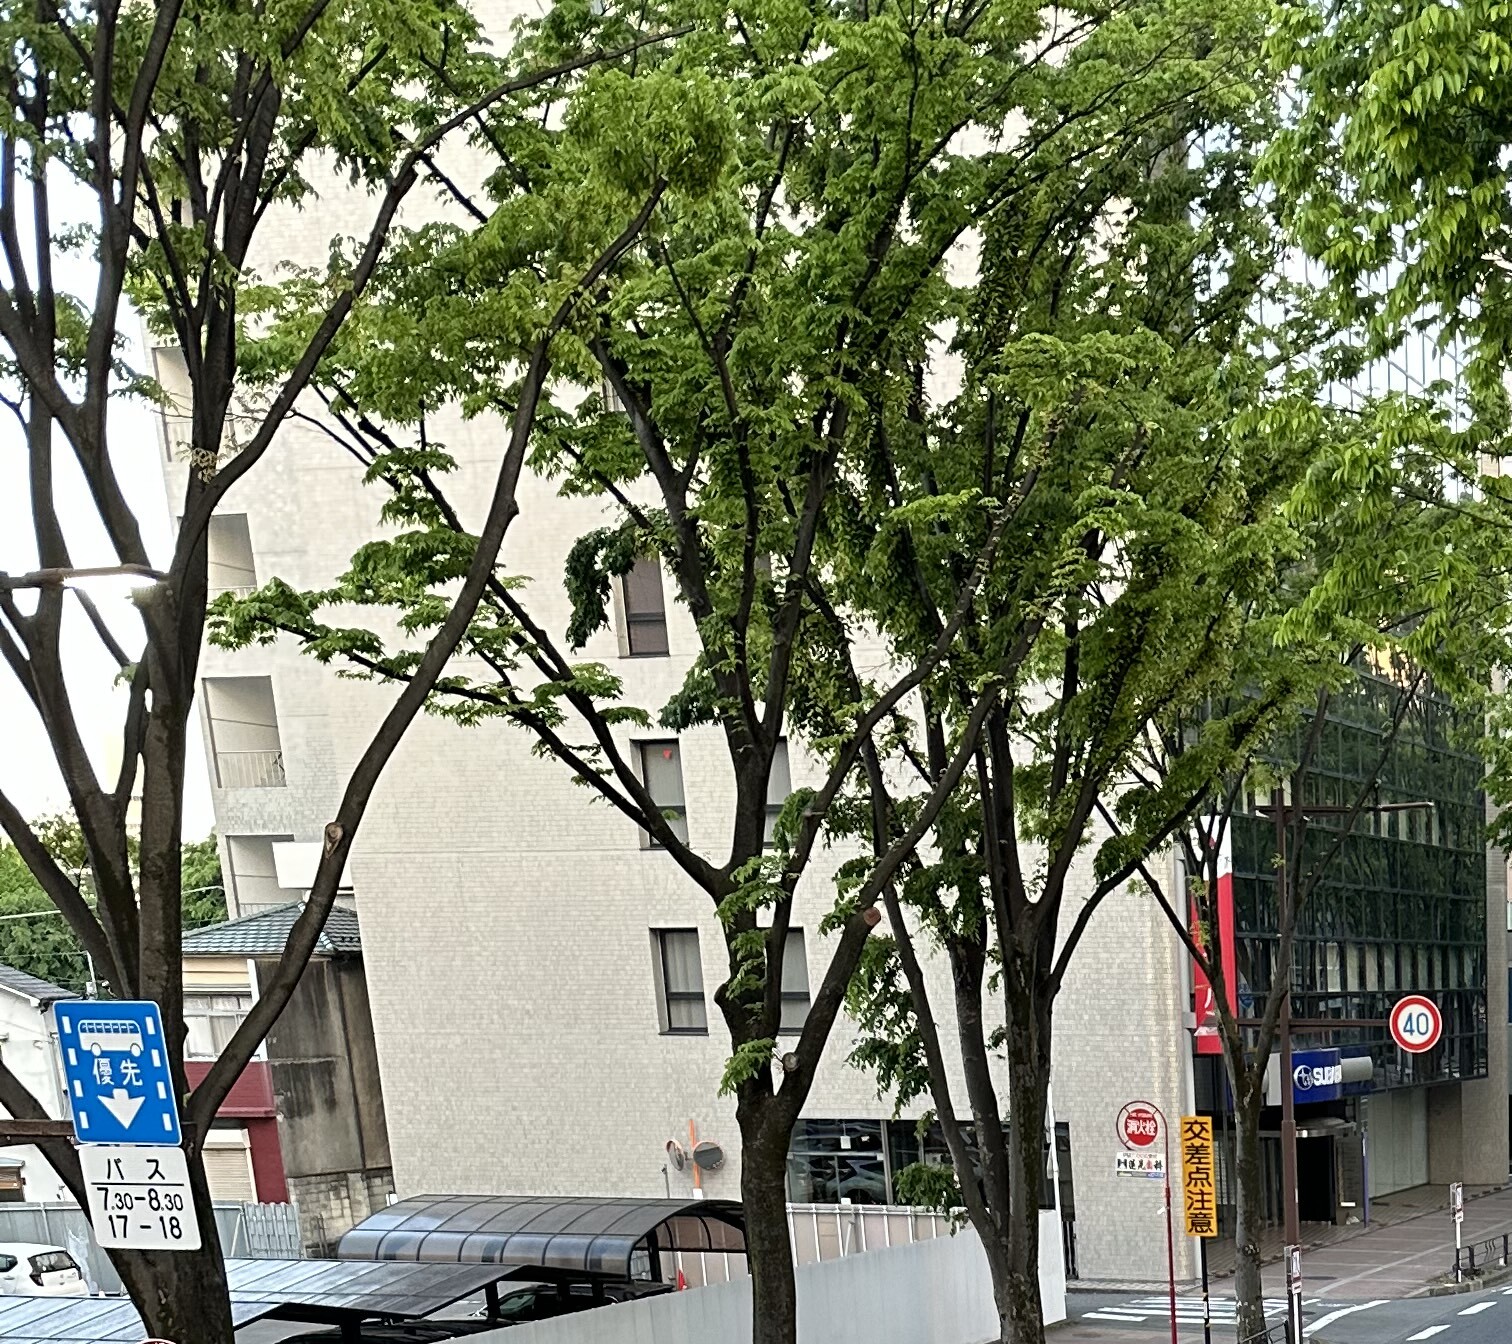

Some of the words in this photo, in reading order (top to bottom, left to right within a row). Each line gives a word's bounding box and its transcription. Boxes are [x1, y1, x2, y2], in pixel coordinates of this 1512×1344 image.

[1403, 1012, 1430, 1036] 40
[92, 1058, 144, 1087] 優先
[1126, 1118, 1157, 1137] 消火栓
[106, 1158, 165, 1181] バス
[1183, 1119, 1214, 1234] 交差点注意
[96, 1186, 184, 1212] 7.30-8.30
